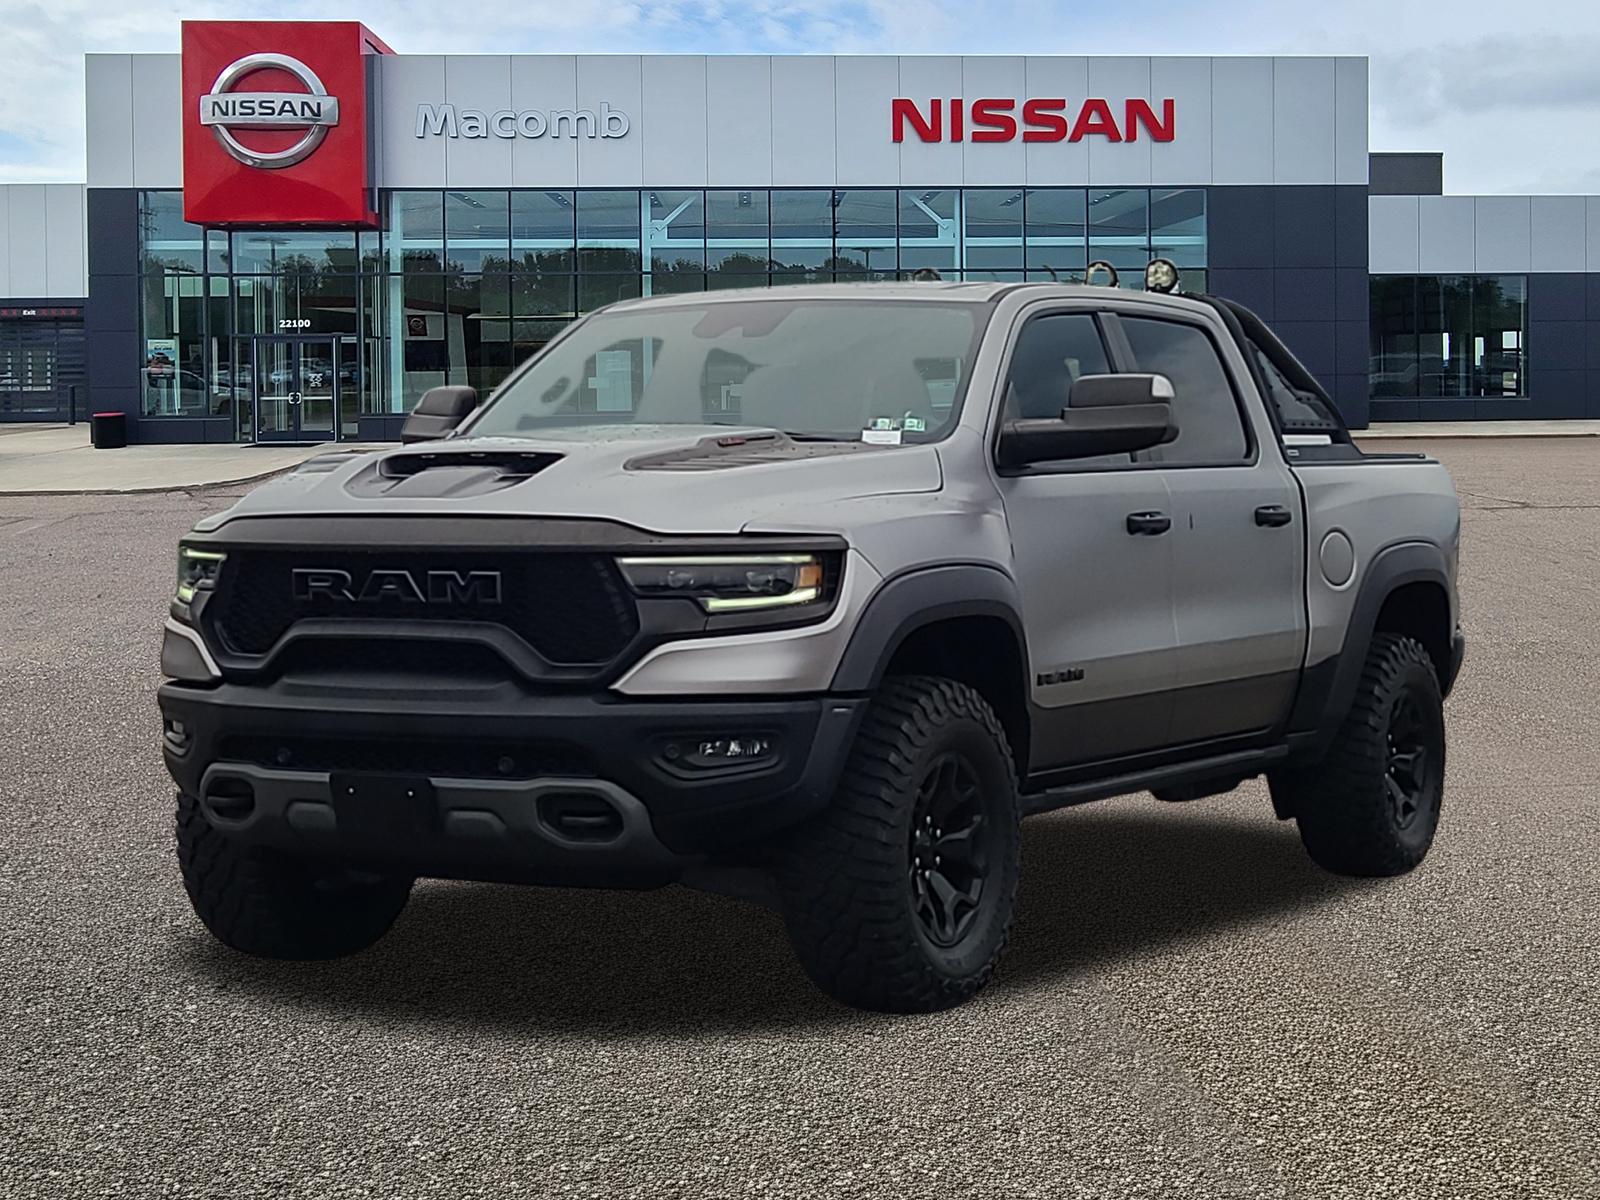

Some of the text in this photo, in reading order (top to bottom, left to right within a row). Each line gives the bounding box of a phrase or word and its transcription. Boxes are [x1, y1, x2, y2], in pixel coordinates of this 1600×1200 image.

[212, 100, 322, 117] NISSAN
[415, 102, 630, 139] Macomb
[892, 98, 1175, 143] NISSAN
[279, 319, 311, 328] 22100
[292, 568, 502, 603] RAM
